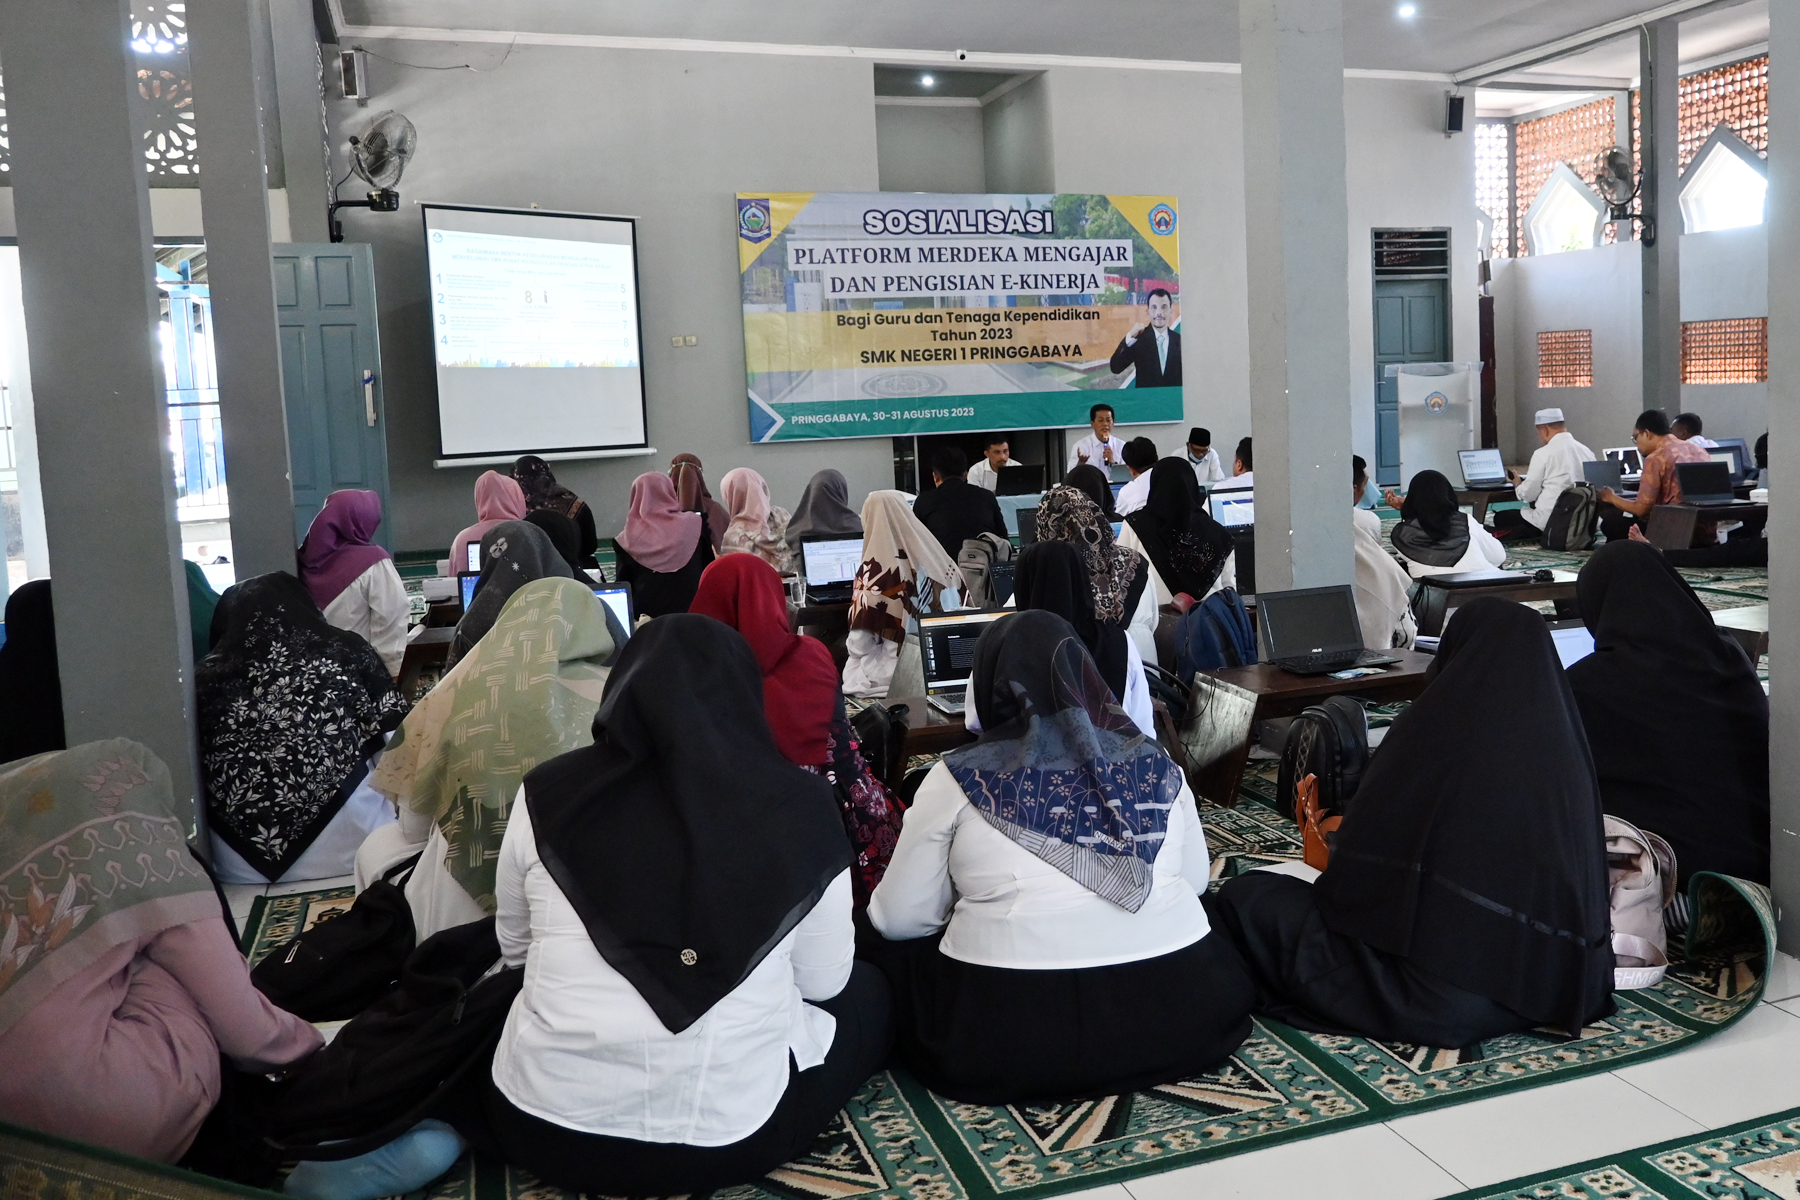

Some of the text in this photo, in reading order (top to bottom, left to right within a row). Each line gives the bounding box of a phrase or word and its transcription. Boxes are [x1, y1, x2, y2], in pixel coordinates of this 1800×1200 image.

[863, 209, 1054, 235] SOSIALISASI
[793, 246, 1129, 266] PLATFORM MERDEKA MENGAJAR
[436, 273, 442, 284] 1
[830, 273, 1100, 293] DAN PENGISIAN E-KINERJA
[620, 284, 626, 293] 5
[437, 293, 445, 304] 2
[524, 290, 533, 304] 8
[621, 301, 627, 311] 6
[439, 314, 447, 325] 3
[622, 320, 628, 330] 7
[836, 309, 1100, 330] Bagi Guru dan Tenaga Kependidikan
[440, 335, 448, 345] 4
[930, 327, 1013, 341] Tahun 2023
[623, 337, 629, 347] 8
[860, 344, 1083, 364] SMK NEGERI 1 PRINGGABAYA
[791, 407, 975, 425] PRINGGABAYA, 30-31 AGUSTUS 2023
